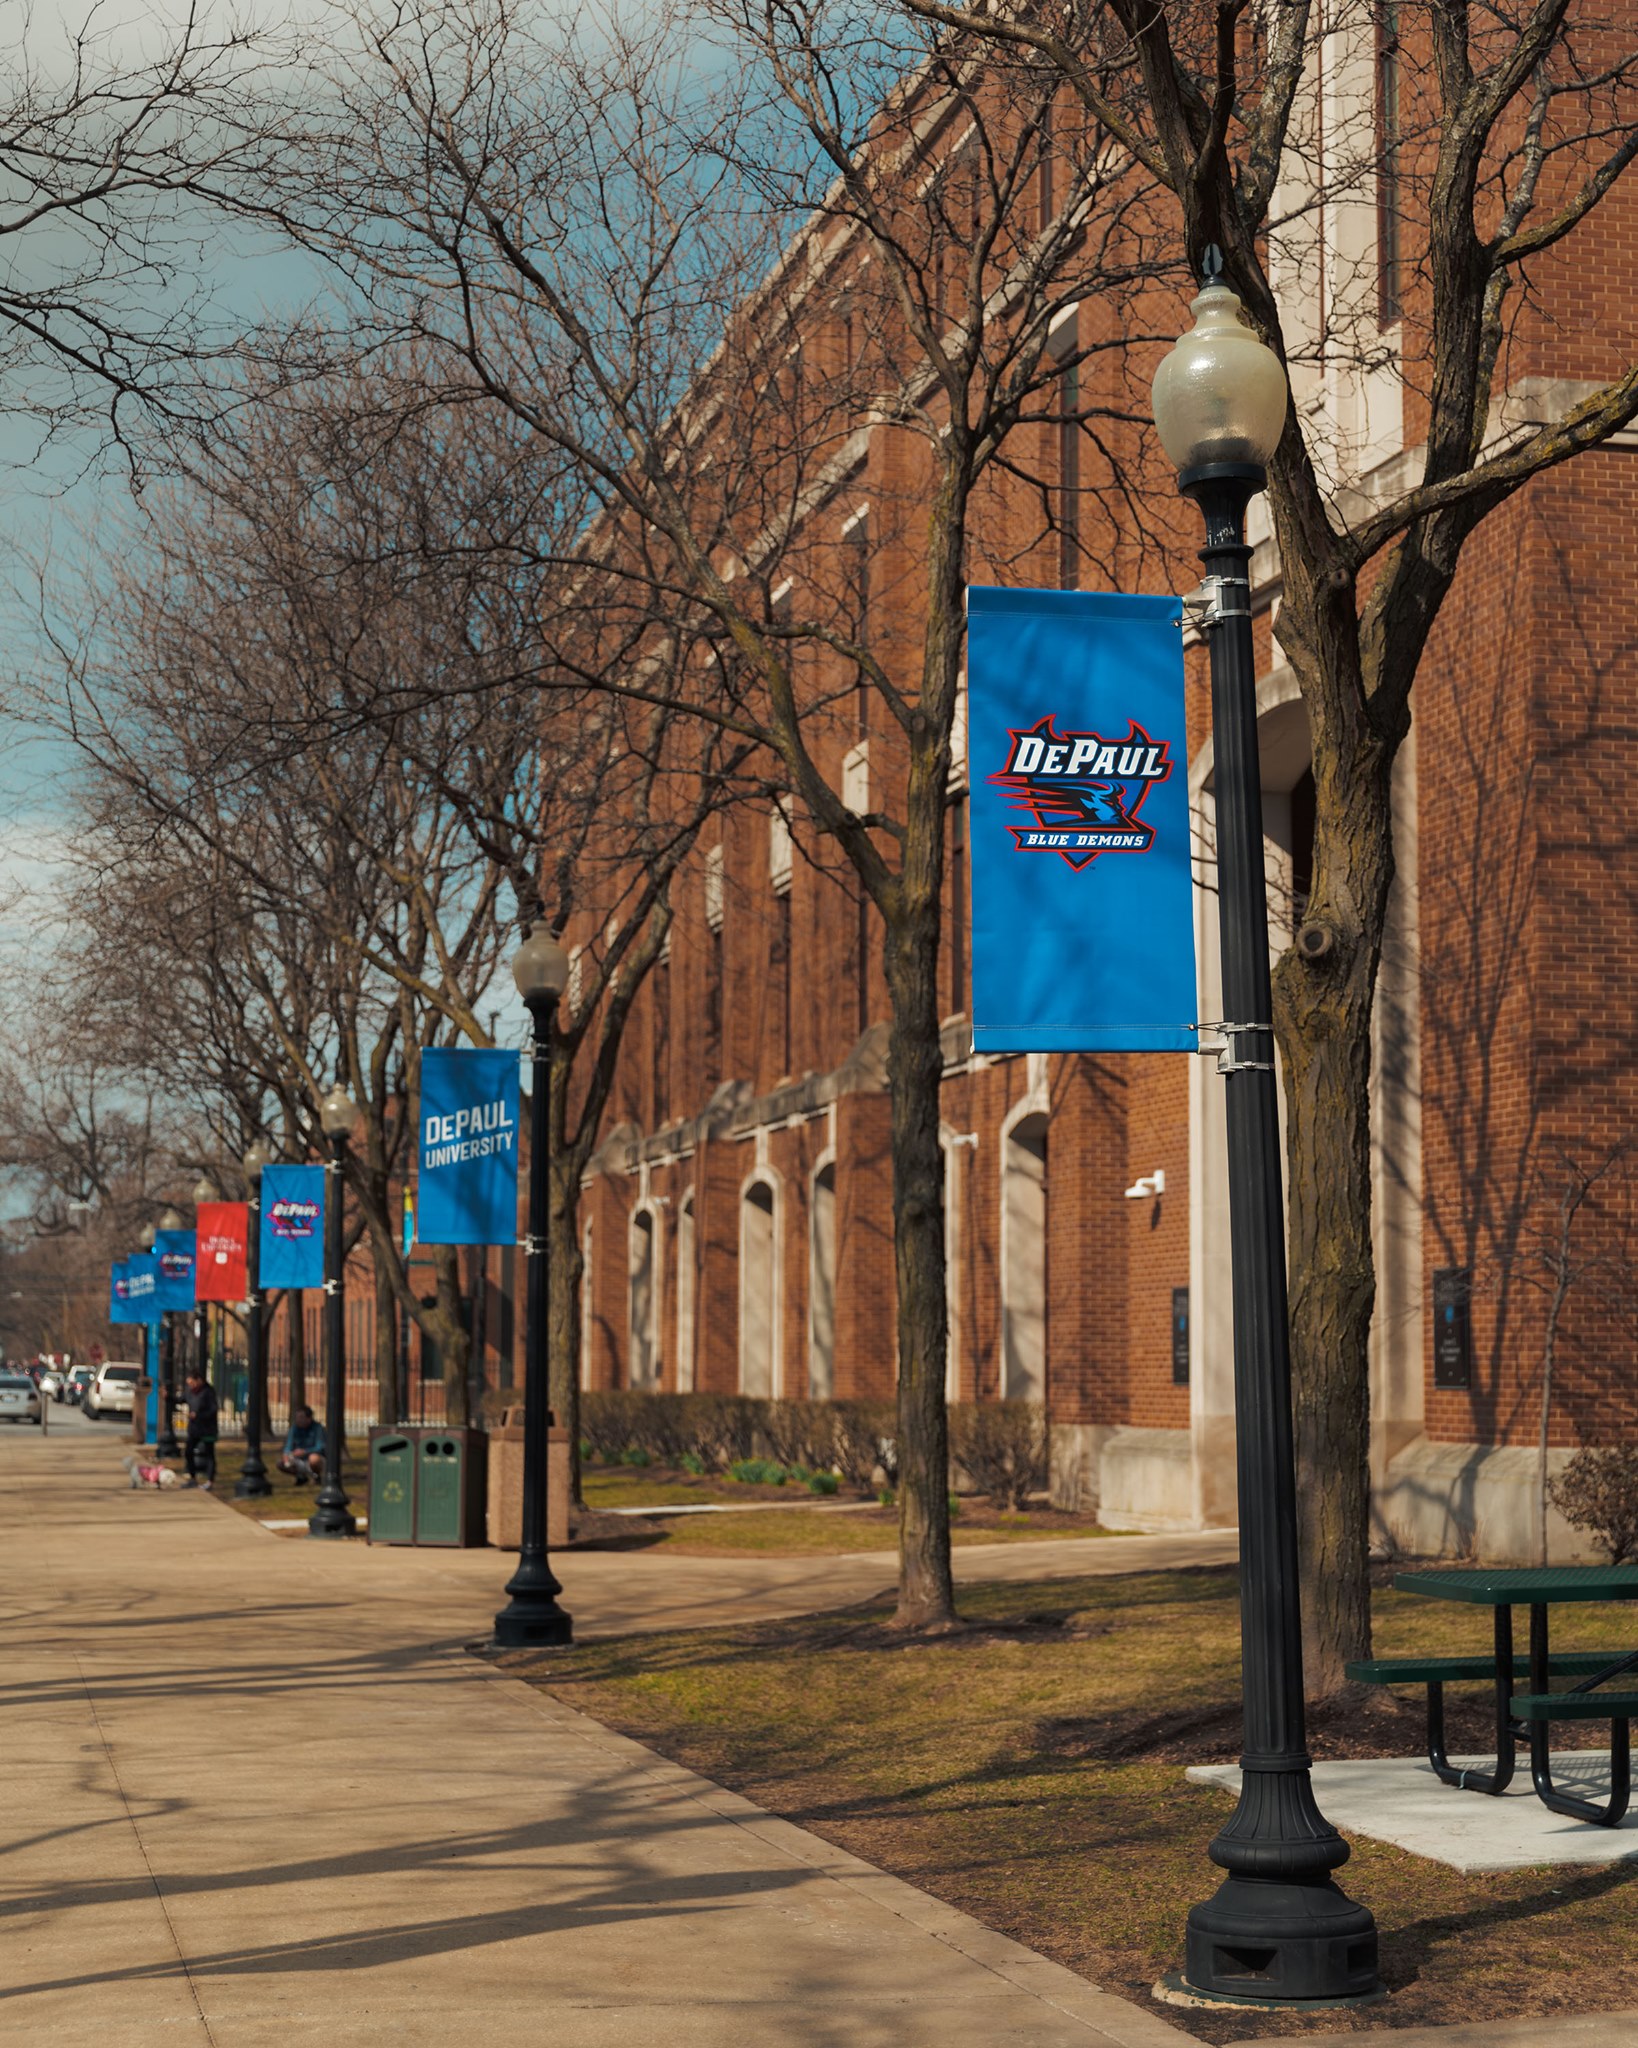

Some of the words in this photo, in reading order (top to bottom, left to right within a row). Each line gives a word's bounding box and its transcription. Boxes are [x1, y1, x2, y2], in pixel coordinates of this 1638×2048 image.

[1027, 833, 1069, 846] BLUE
[1076, 835, 1144, 847] DEMONS
[425, 1100, 513, 1145] DEPAUL
[425, 1131, 513, 1169] UNIVERSITY
